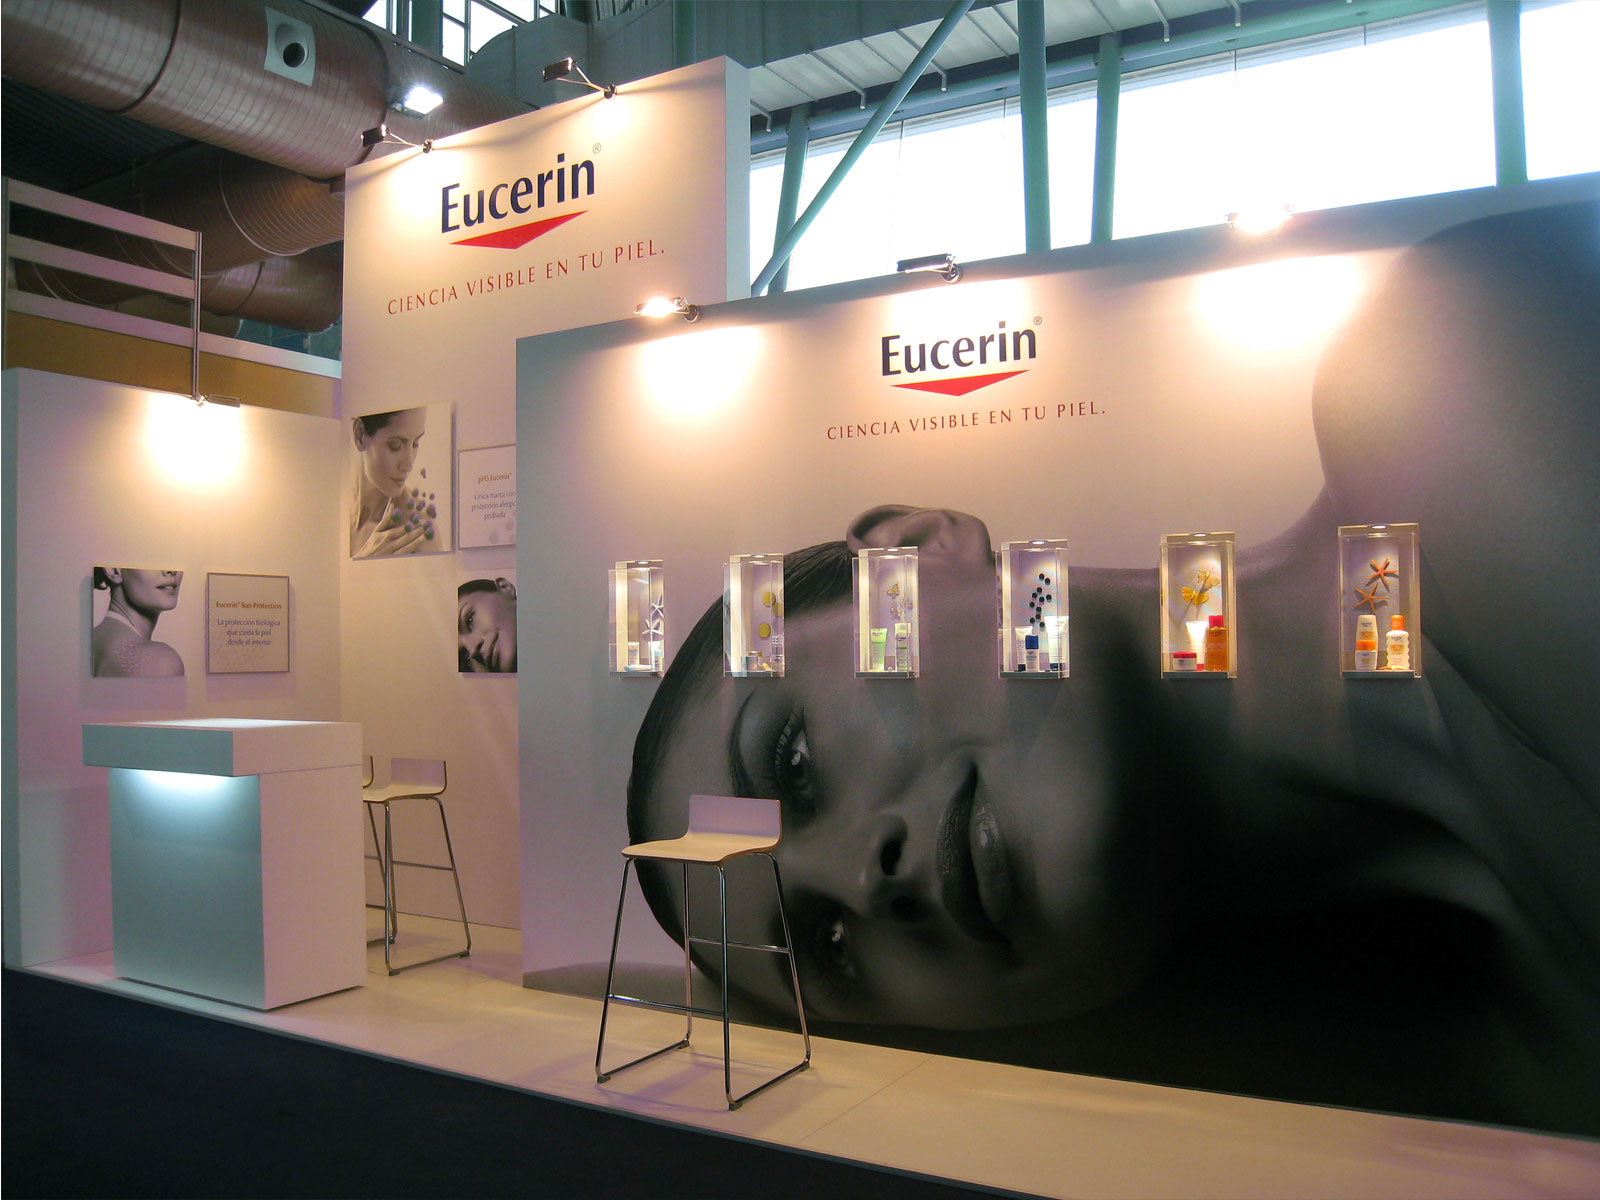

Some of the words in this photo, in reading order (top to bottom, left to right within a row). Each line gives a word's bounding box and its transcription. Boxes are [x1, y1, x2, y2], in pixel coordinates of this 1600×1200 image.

[387, 285, 459, 316] CIENCIA
[466, 266, 536, 298] VISIBLE
[545, 259, 569, 279] EN
[578, 251, 604, 272] TU
[614, 239, 665, 264] PIEL.
[827, 420, 901, 441] CIENCIA
[908, 412, 979, 432] VISIBLE
[989, 408, 1012, 425] EN
[1022, 405, 1046, 422] TU
[1057, 400, 1106, 418] PIEL.
[241, 601, 252, 609] Sun
[252, 602, 282, 610] Protection
[227, 638, 245, 646] desde
